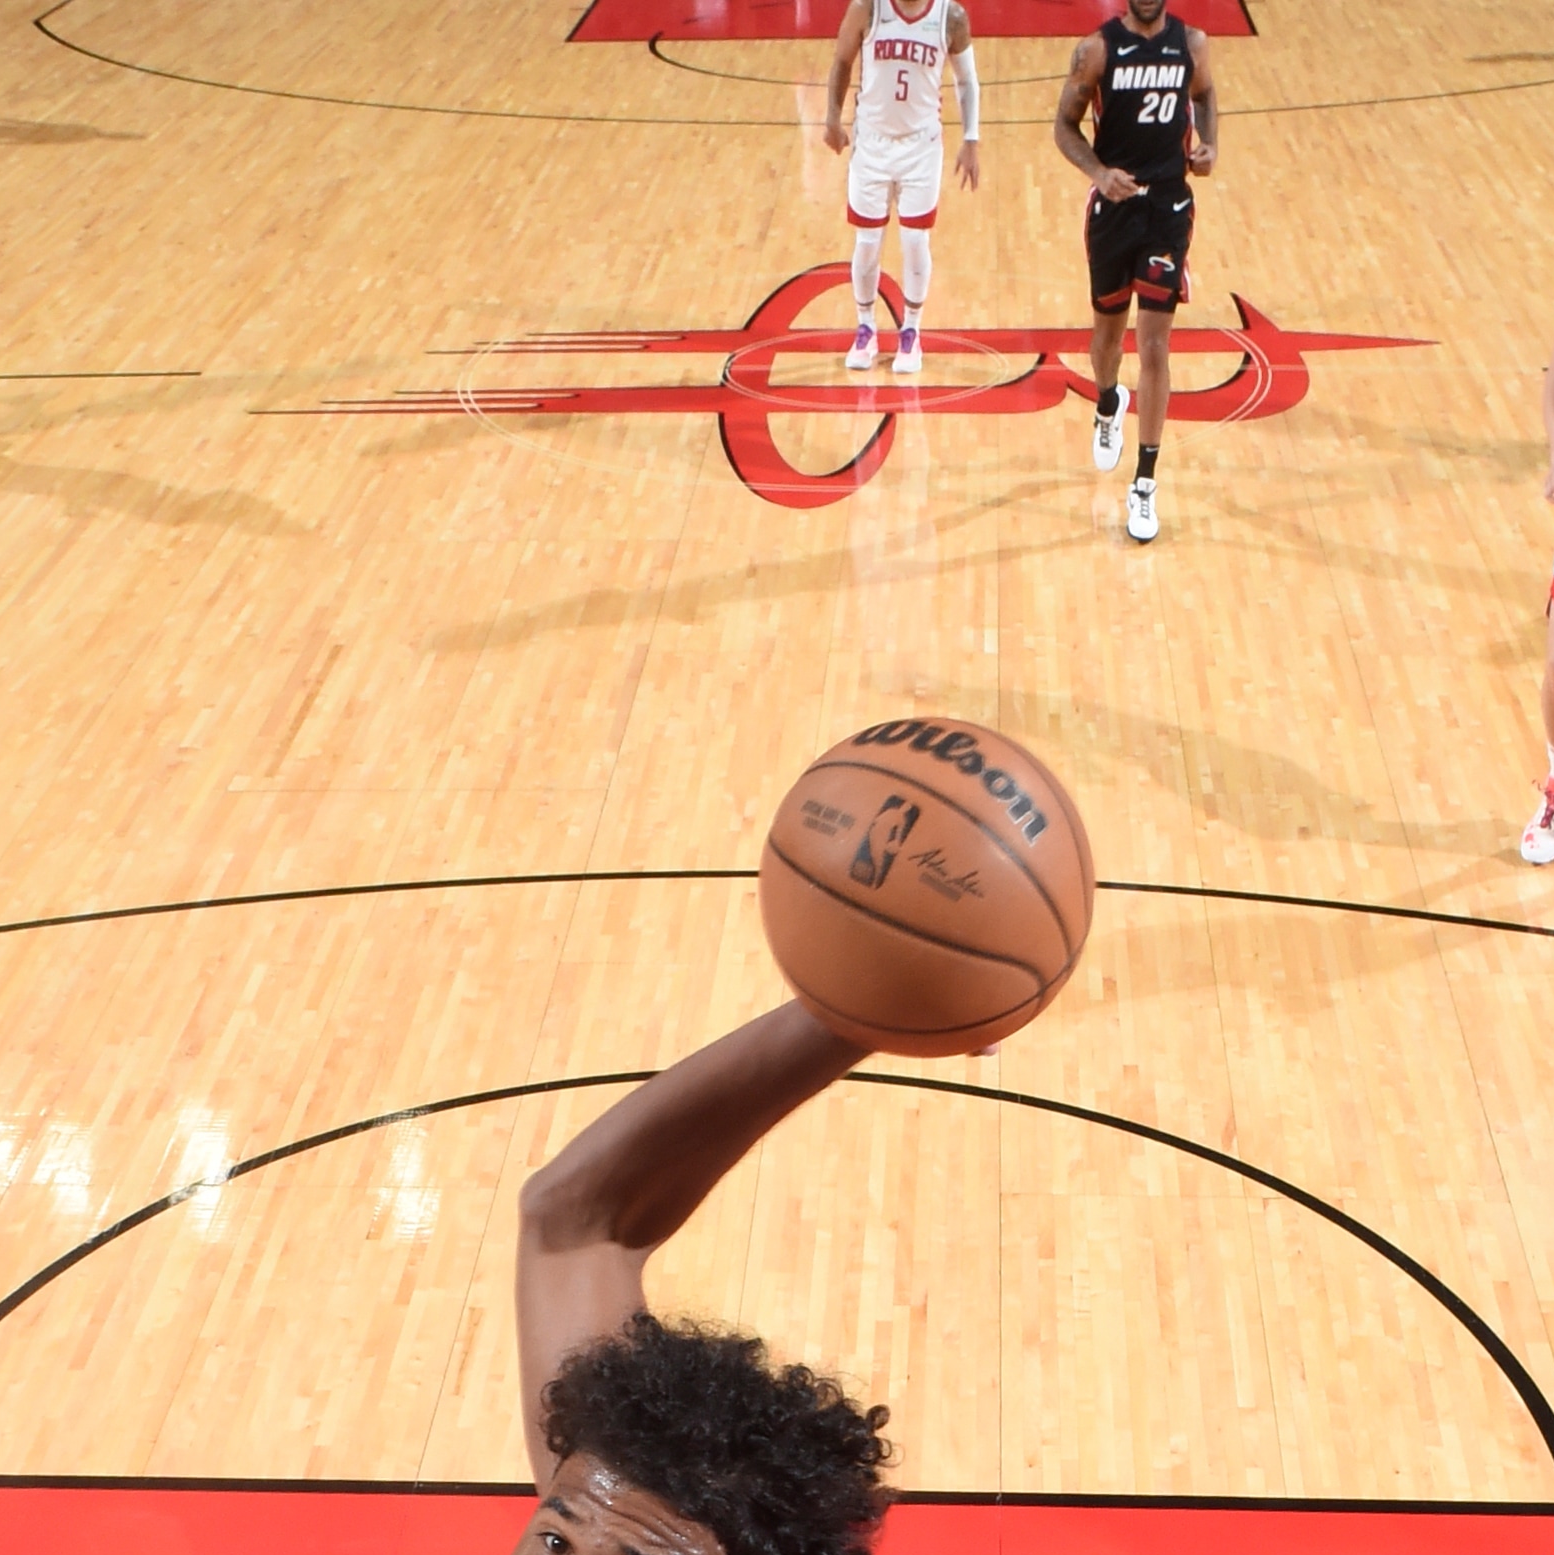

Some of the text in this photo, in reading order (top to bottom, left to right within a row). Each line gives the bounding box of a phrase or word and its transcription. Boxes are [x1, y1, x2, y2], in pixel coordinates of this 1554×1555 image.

[874, 38, 938, 67] ROCKETS
[895, 69, 909, 102] 5
[1112, 65, 1185, 90] MIAMI
[1137, 92, 1178, 124] 20
